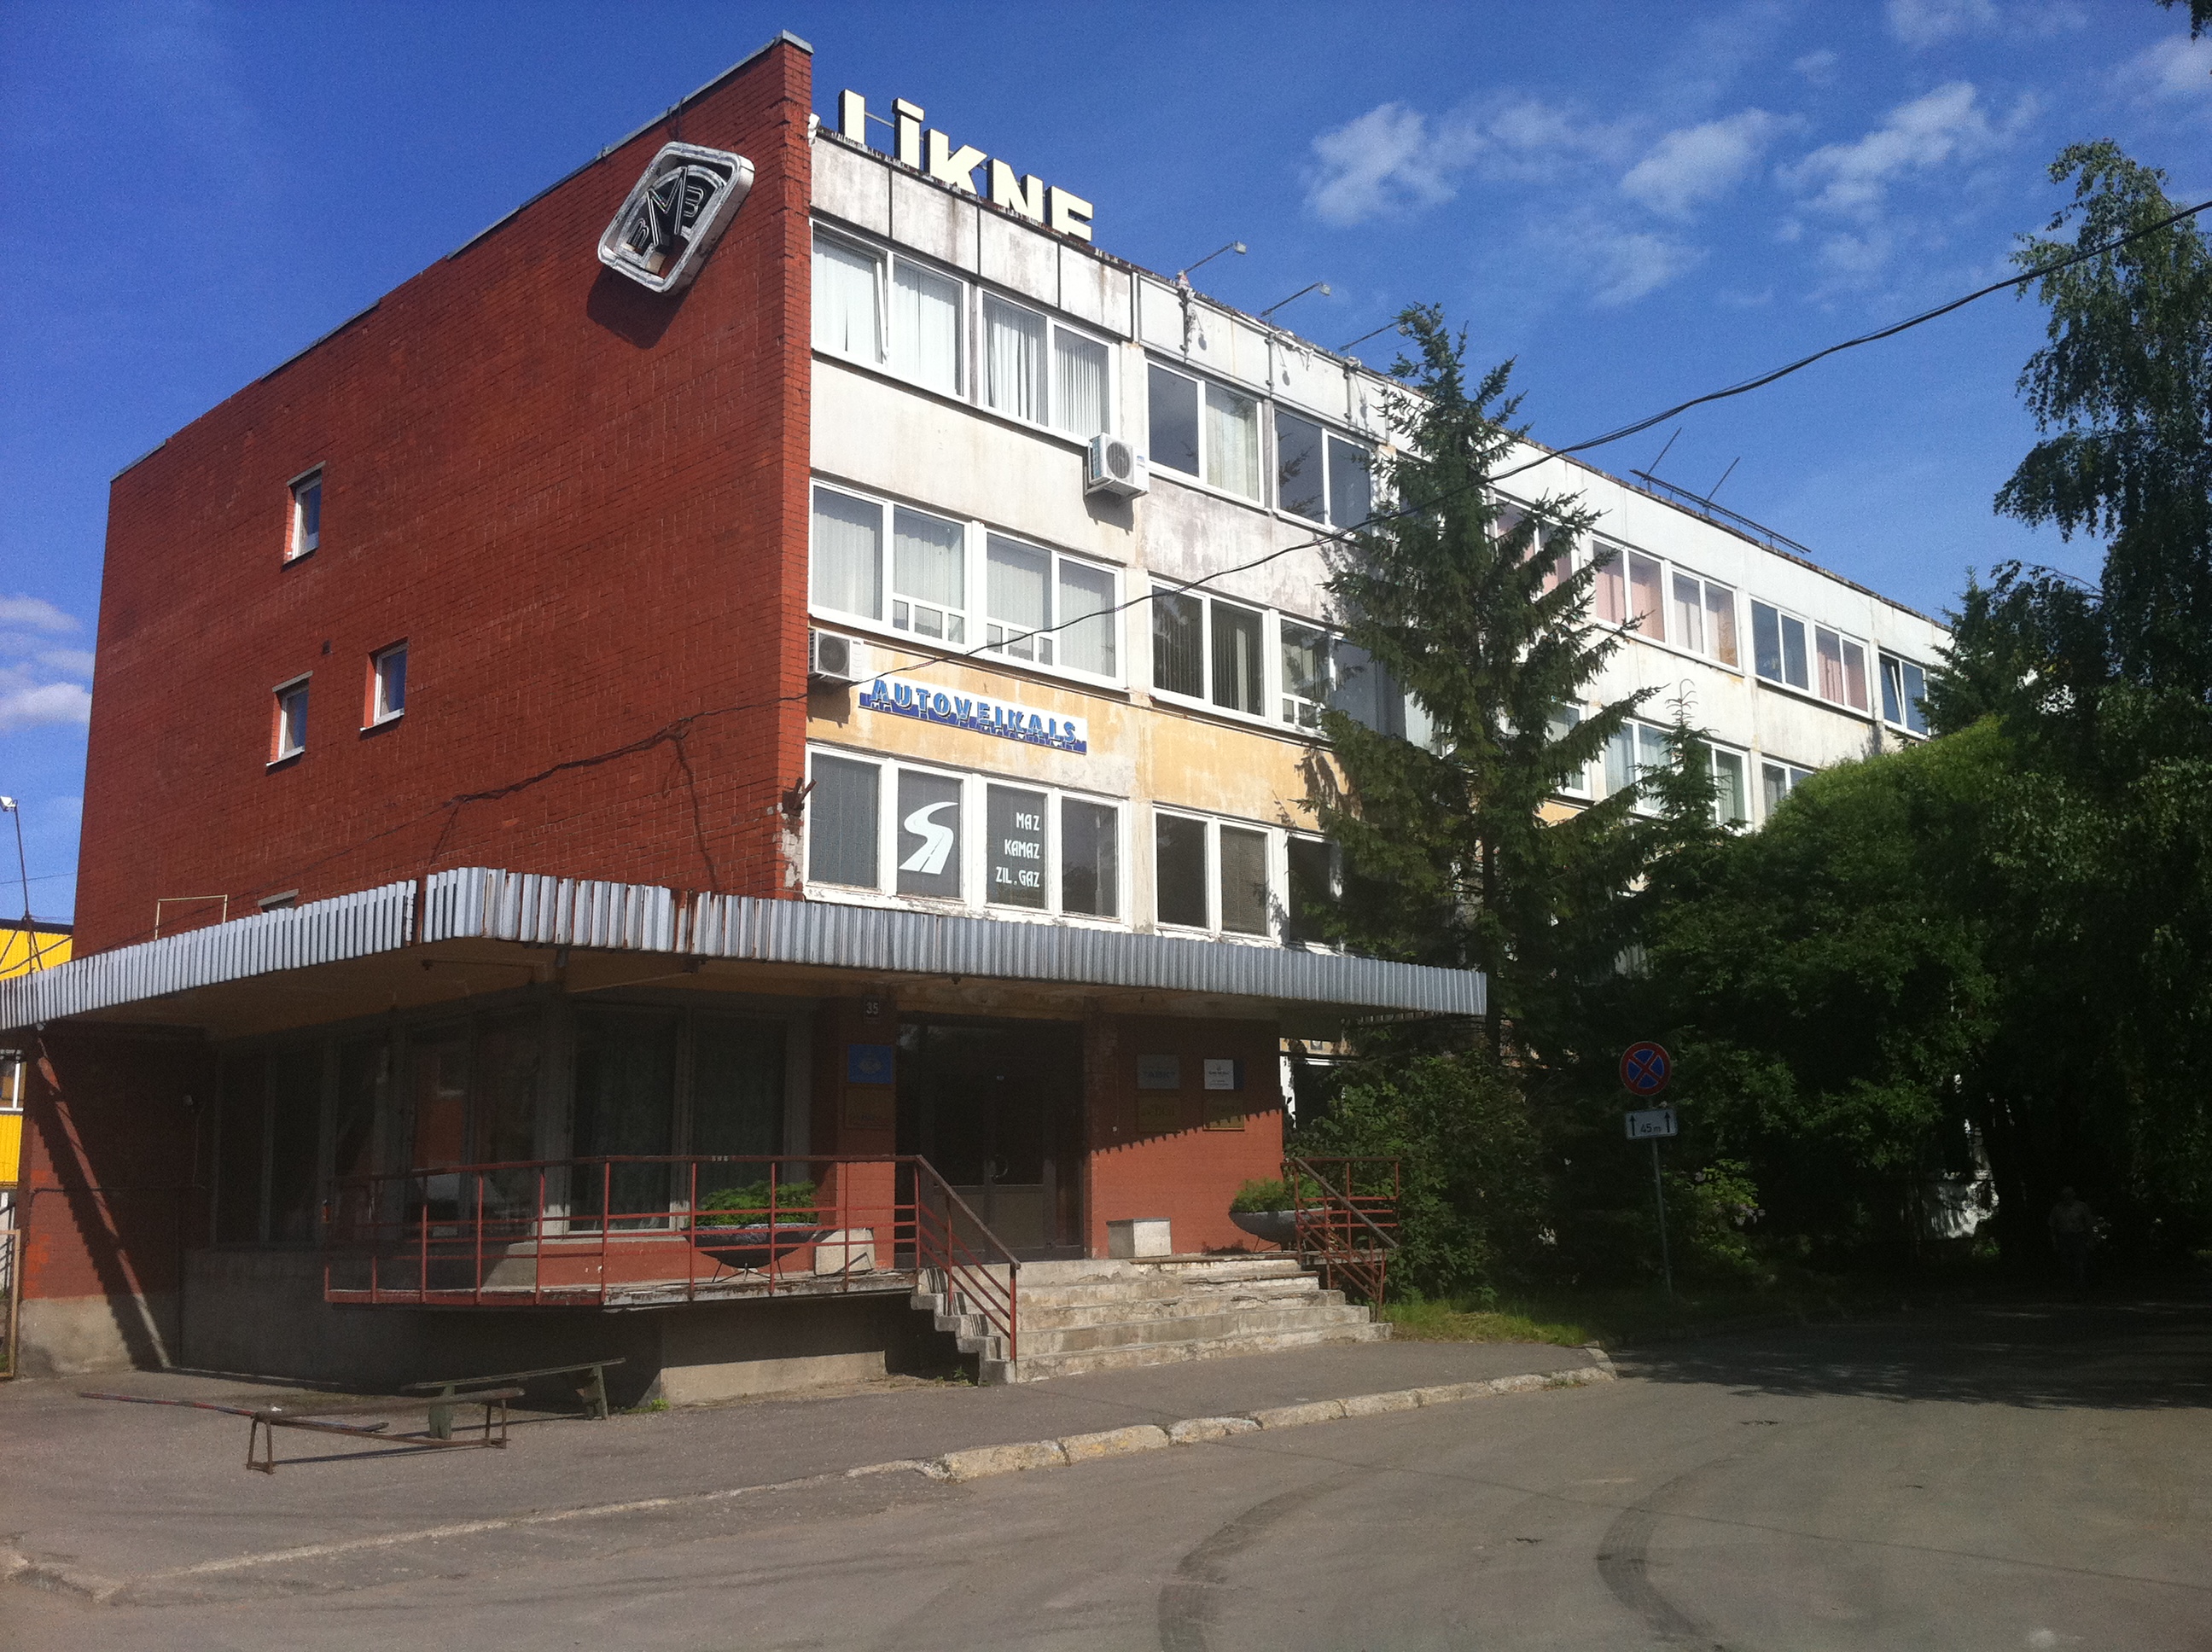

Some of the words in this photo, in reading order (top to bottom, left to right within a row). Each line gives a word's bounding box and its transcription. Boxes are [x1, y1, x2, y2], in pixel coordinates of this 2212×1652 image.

[870, 678, 1077, 745] AUTOVEIKALS
[1016, 811, 1040, 831] MAZ
[1004, 838, 1040, 859] KAMAZ
[865, 1001, 879, 1015] 35
